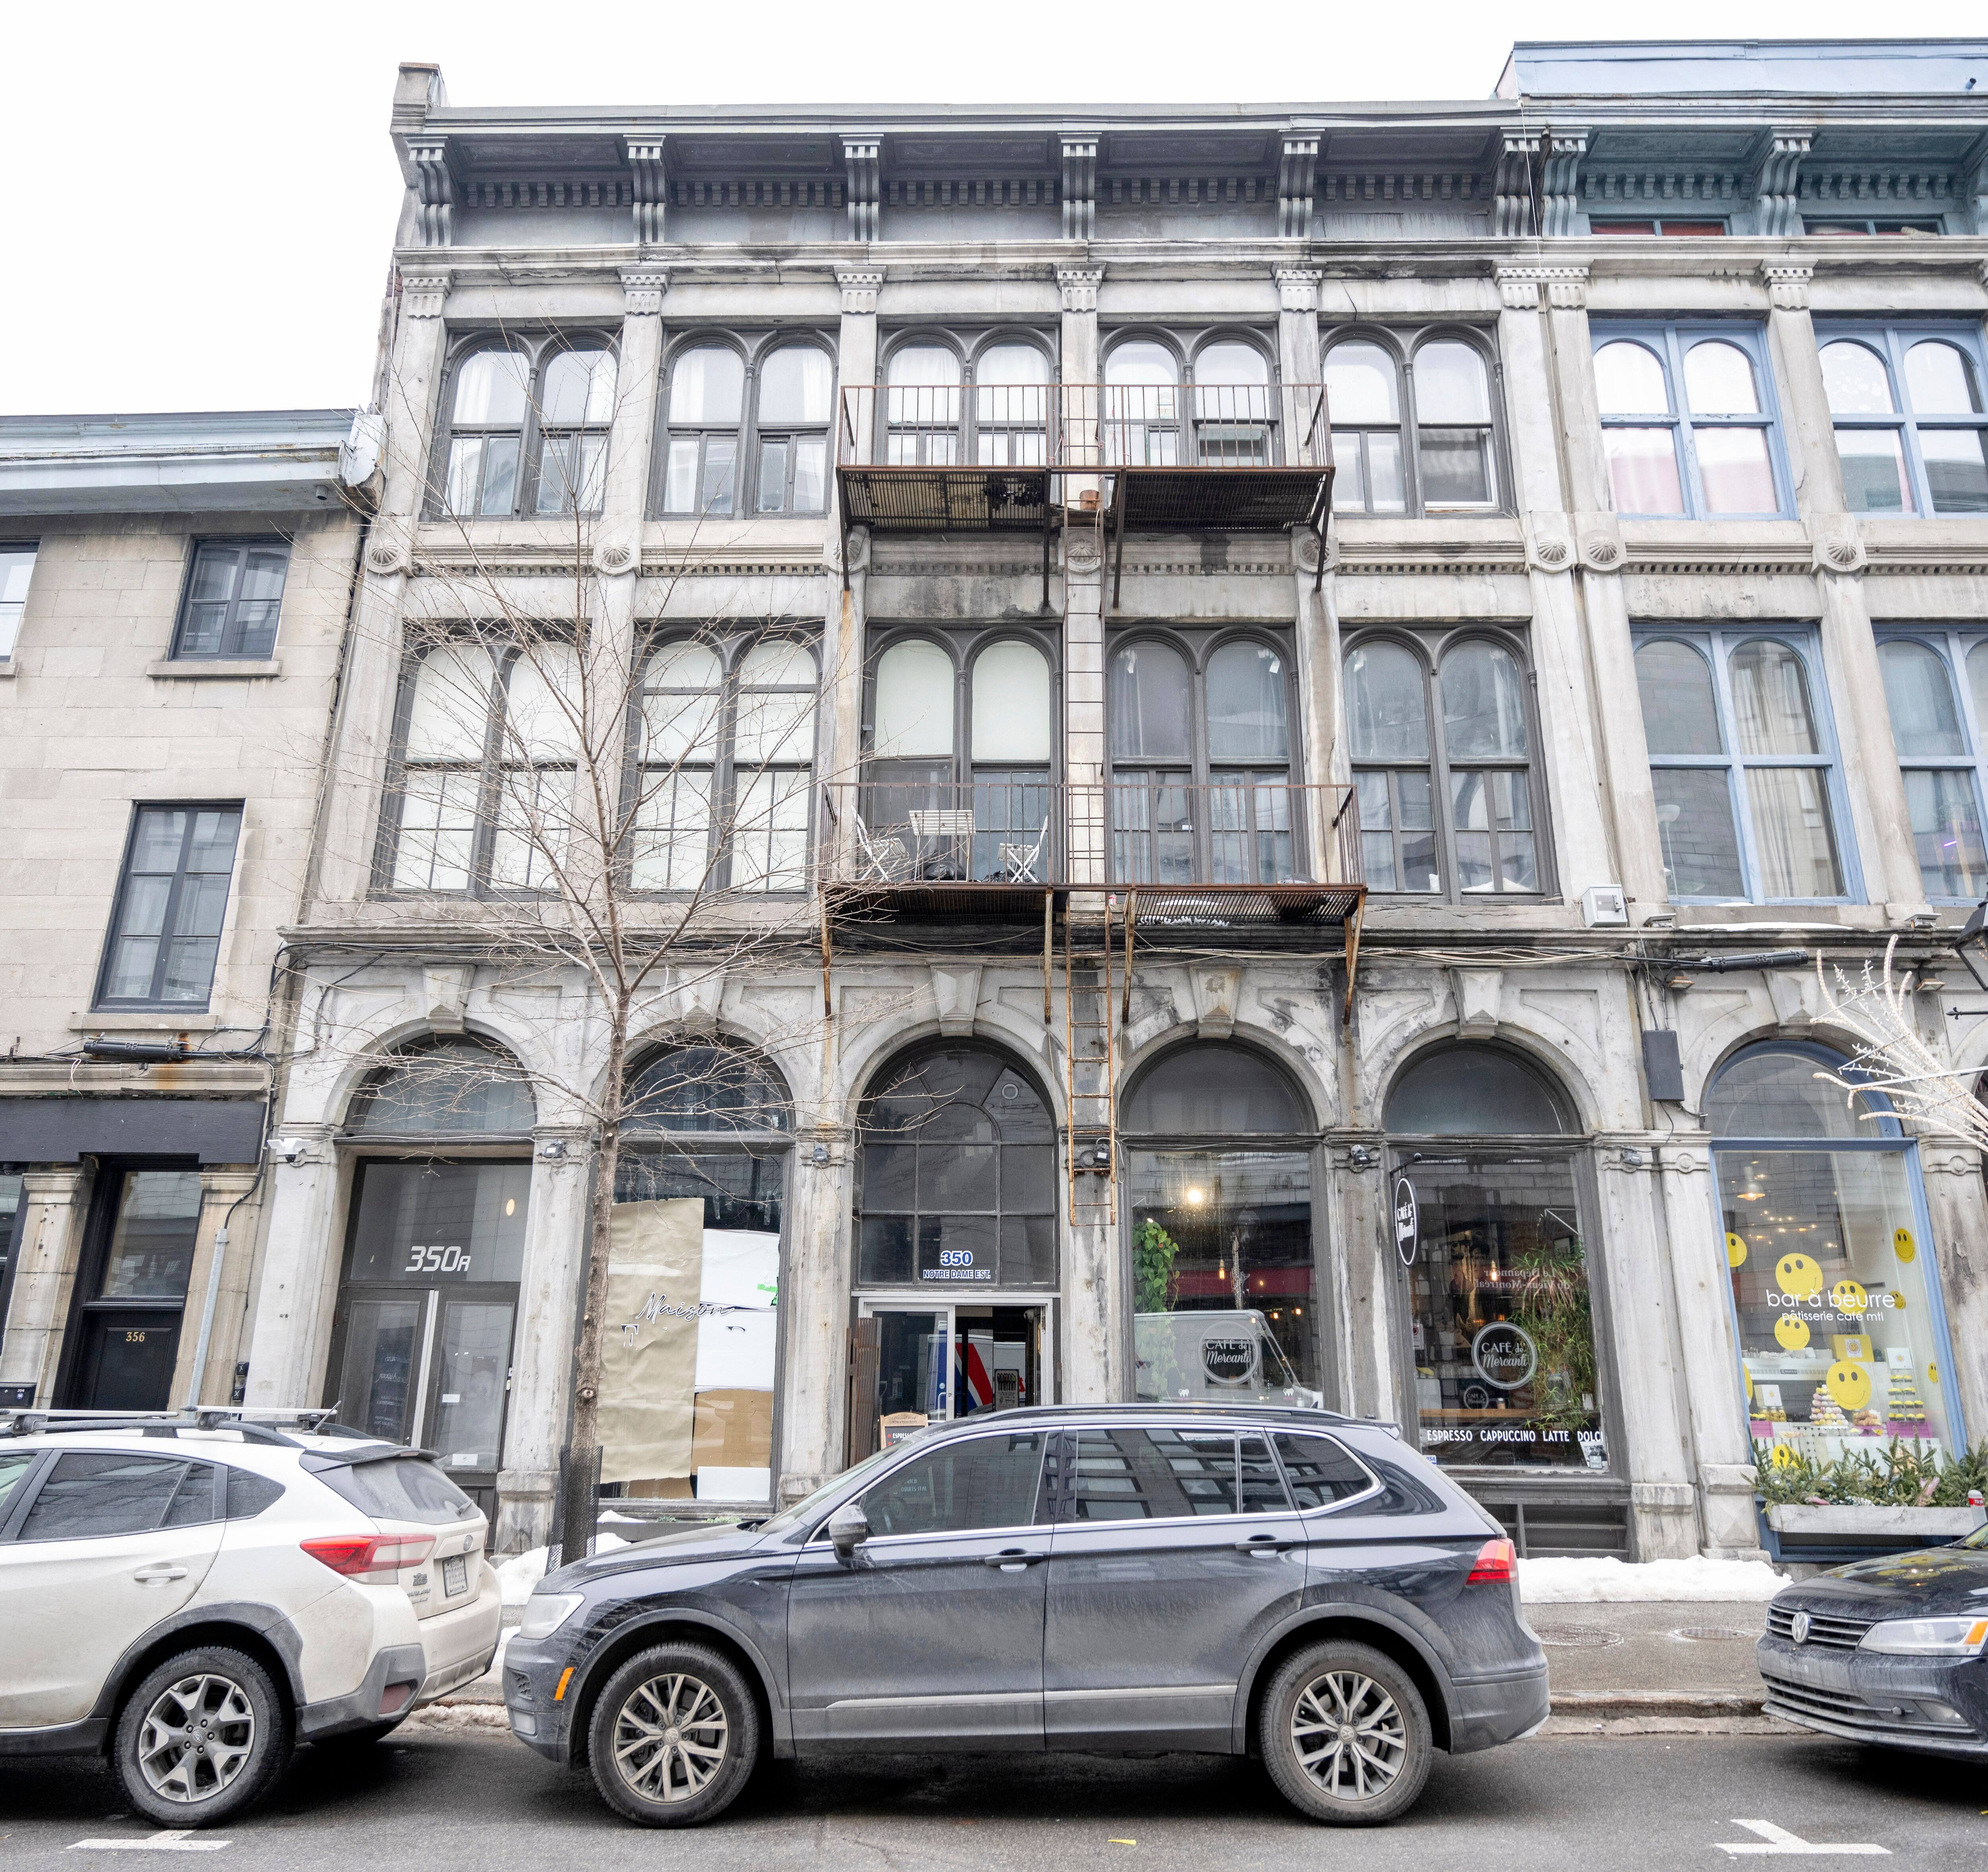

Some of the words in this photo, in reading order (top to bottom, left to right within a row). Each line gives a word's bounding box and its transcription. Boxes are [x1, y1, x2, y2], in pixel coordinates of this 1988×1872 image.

[1397, 1202, 1408, 1221] CAFÉ
[405, 1246, 471, 1271] 350A
[940, 1250, 973, 1266] 350
[923, 1269, 949, 1278] NOTRE
[951, 1270, 973, 1278] DAME
[975, 1270, 991, 1278] EST.
[1766, 1289, 1801, 1307] bar
[1808, 1289, 1821, 1307] à
[1828, 1290, 1895, 1307] beurre
[636, 1292, 735, 1324] Maison
[1782, 1310, 1833, 1322] pâtisserie
[1837, 1311, 1863, 1321] café
[1867, 1311, 1884, 1321] mtl
[126, 1332, 145, 1342] 356
[1481, 1341, 1512, 1353] CAFÉ
[1206, 1351, 1251, 1364] Mercanti
[1483, 1354, 1528, 1368] Mercanti
[1427, 1430, 1473, 1441] ESPRESSO
[1480, 1430, 1536, 1442] CAPPUCCINO
[1543, 1430, 1570, 1441] LATTE
[1577, 1431, 1603, 1442] DOLCI
